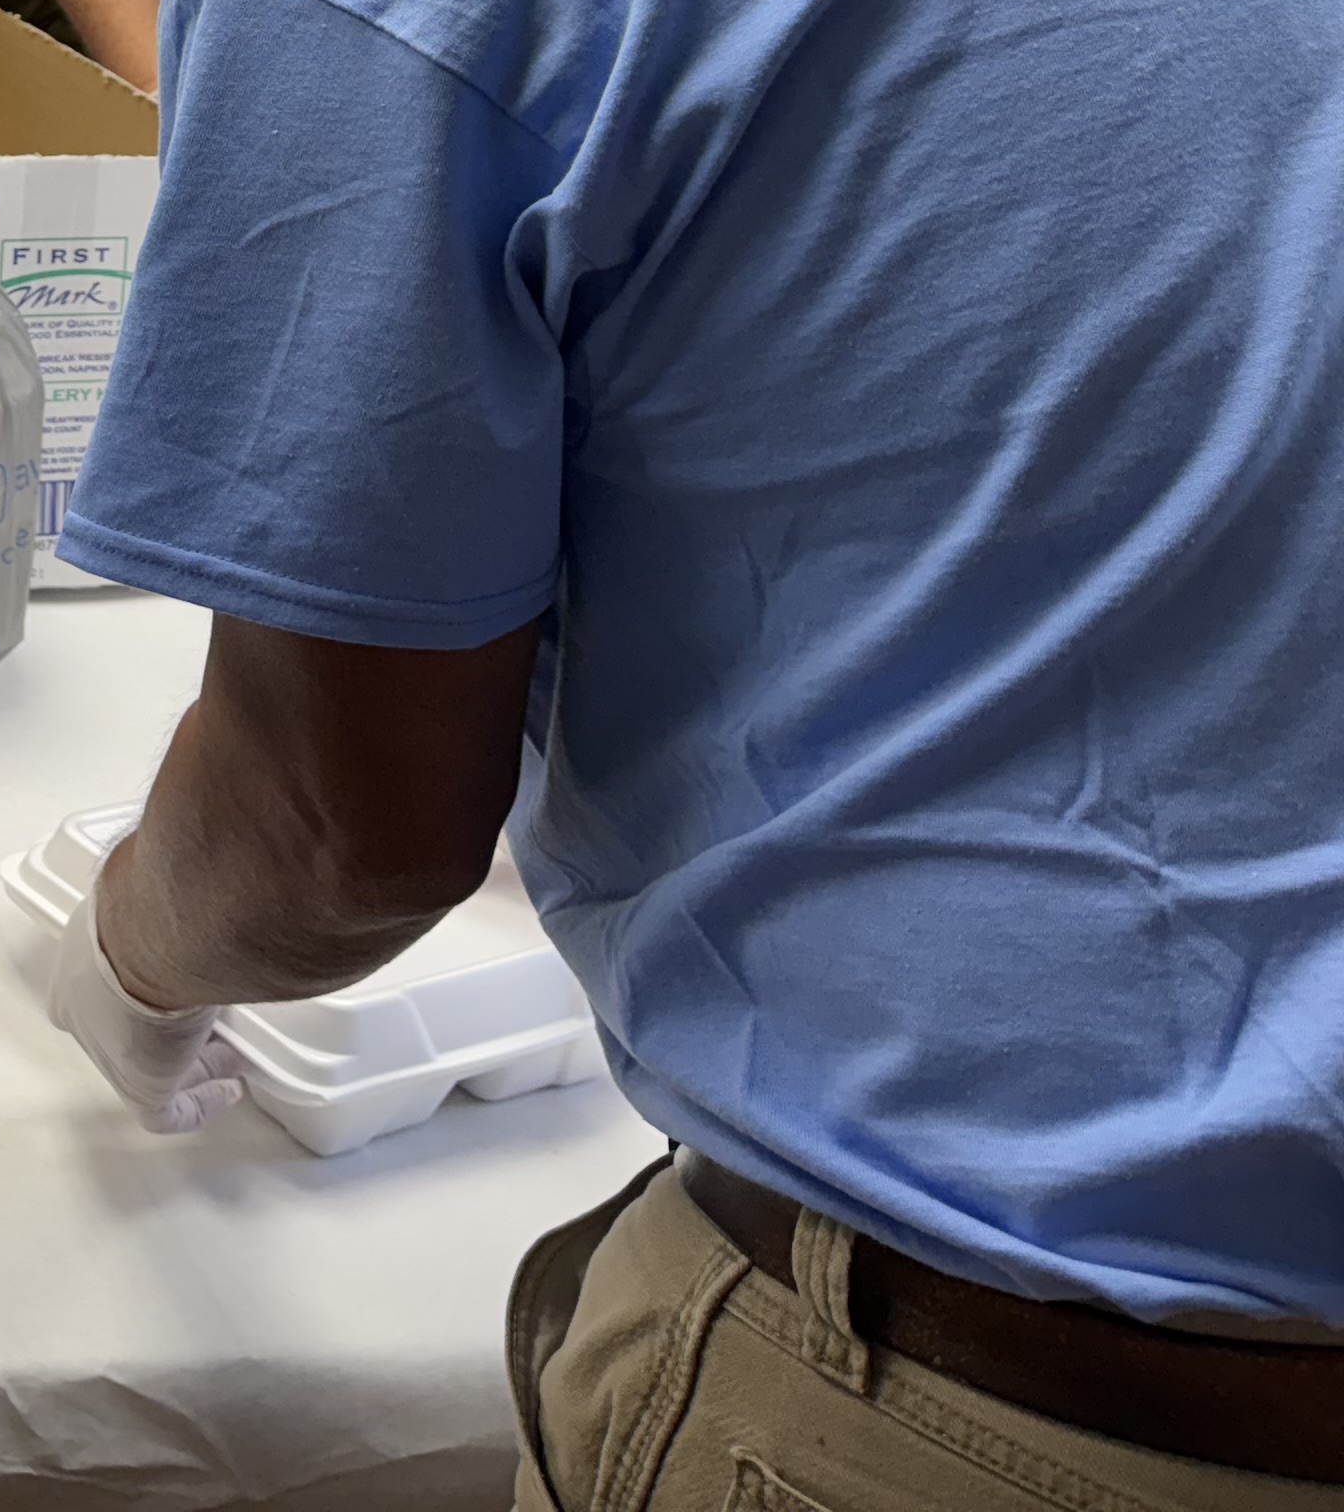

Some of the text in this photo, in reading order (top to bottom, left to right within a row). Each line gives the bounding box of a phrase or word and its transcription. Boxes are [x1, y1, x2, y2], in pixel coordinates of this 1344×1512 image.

[12, 247, 111, 265] FIRST
[7, 281, 108, 310] Mark
[48, 320, 64, 329] OF
